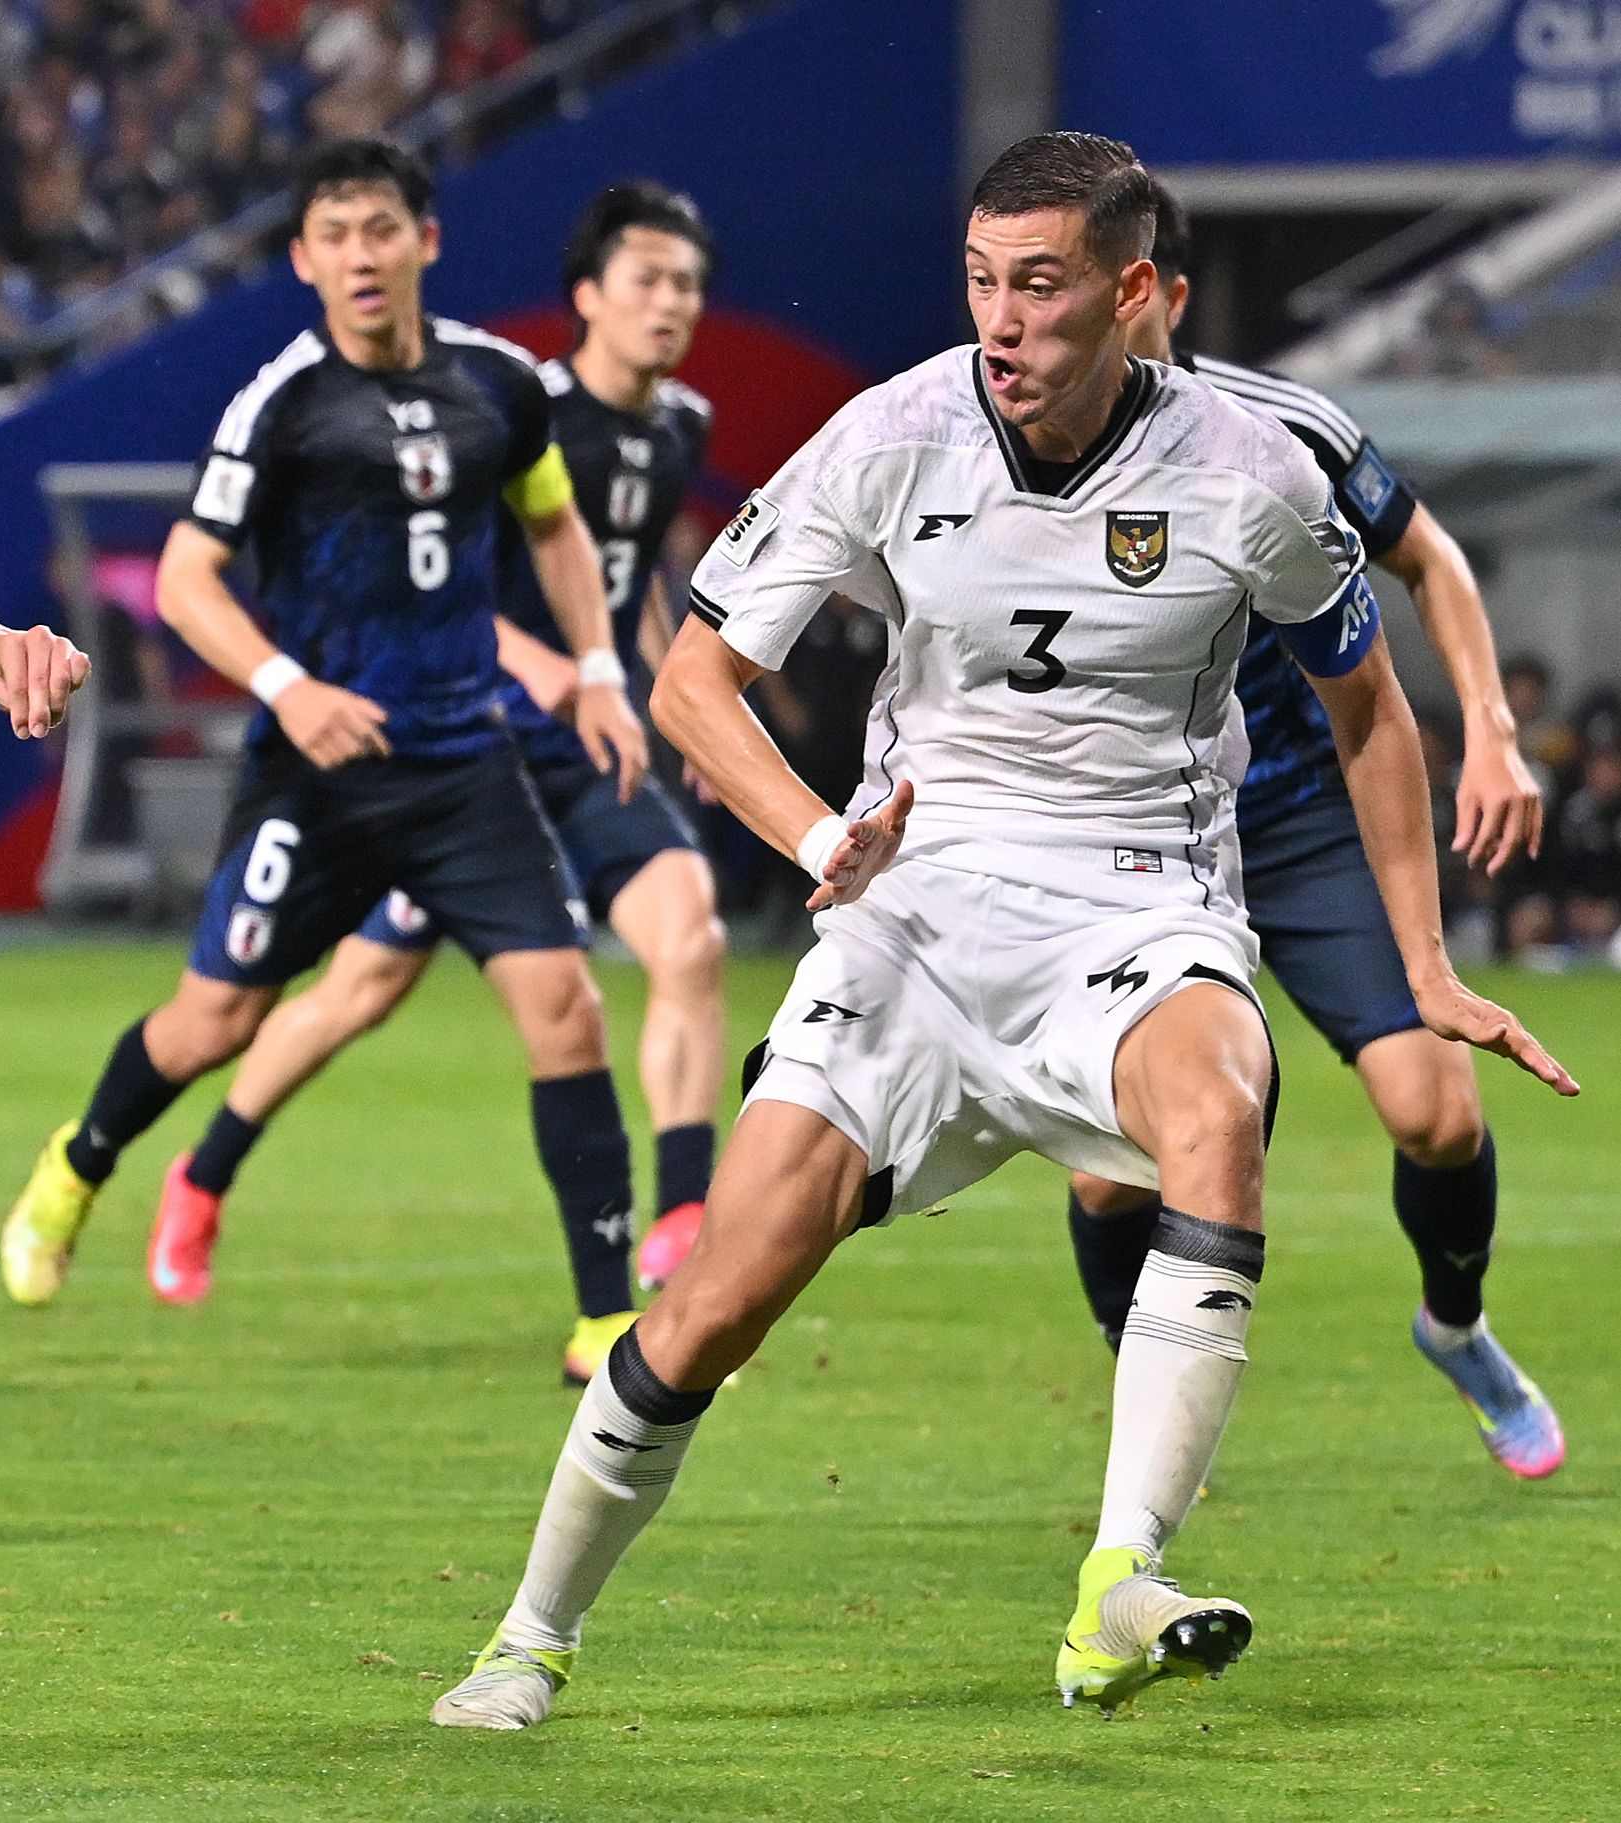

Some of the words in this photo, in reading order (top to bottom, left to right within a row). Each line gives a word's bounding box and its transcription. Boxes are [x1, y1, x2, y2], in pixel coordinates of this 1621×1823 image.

[408, 510, 450, 591] 6
[1116, 513, 1159, 521] INDONESIA
[1007, 609, 1074, 694] 3
[243, 818, 301, 904] 6
